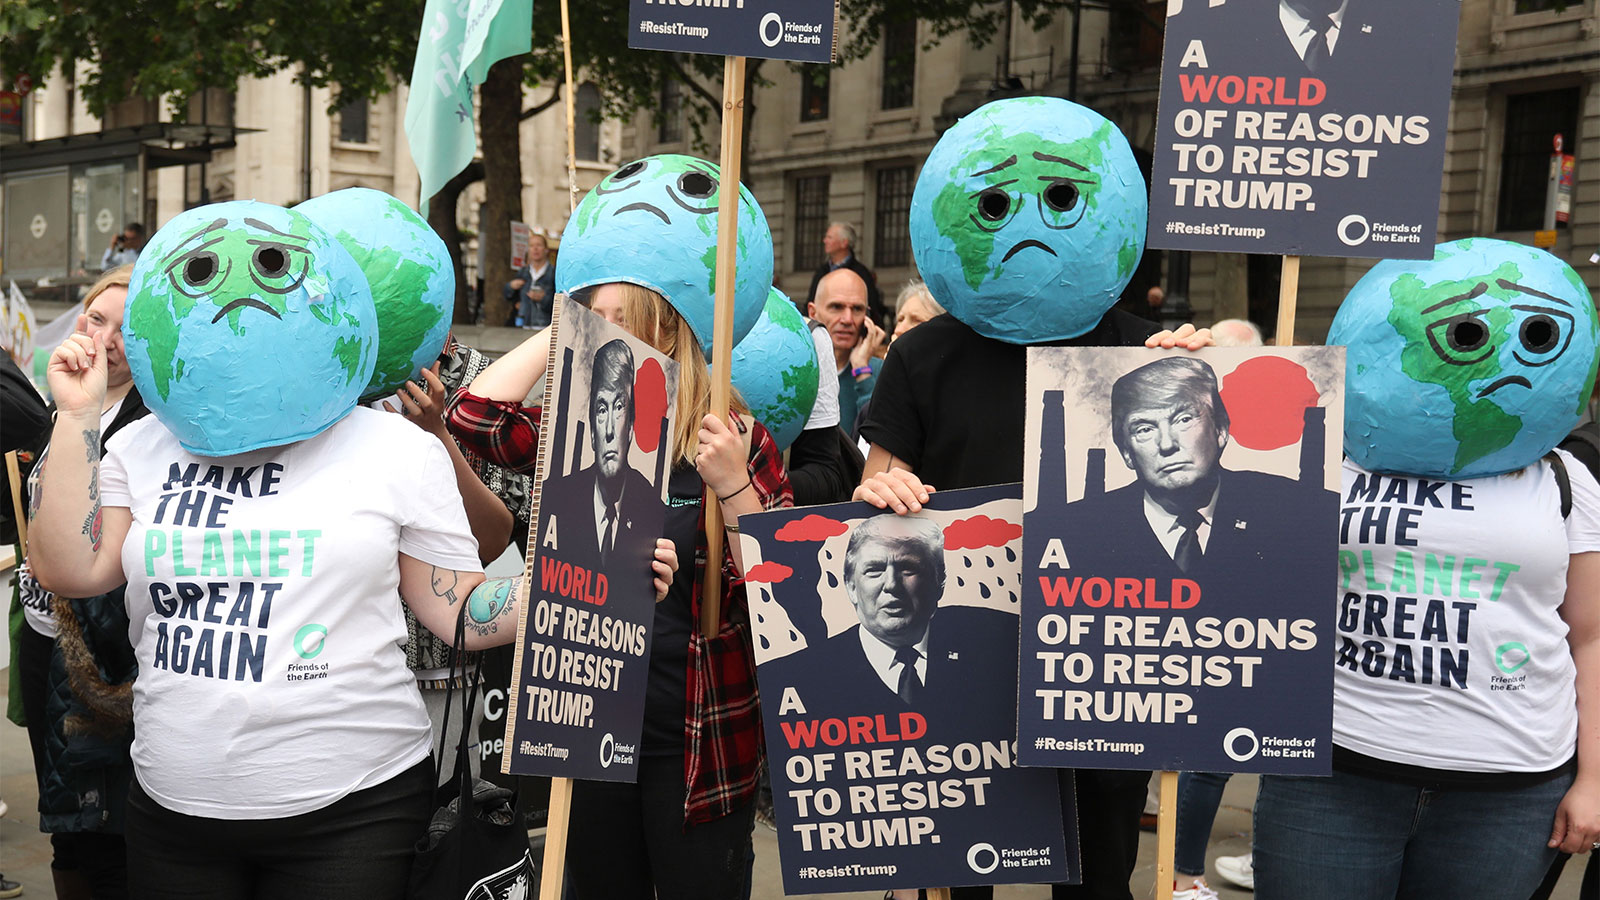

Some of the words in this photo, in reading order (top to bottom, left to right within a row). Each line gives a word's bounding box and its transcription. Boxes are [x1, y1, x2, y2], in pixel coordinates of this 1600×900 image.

[640, 21, 709, 39] #ResistTrump
[784, 33, 797, 43] the
[798, 34, 820, 45] Earth
[785, 22, 812, 33] Friends
[813, 24, 822, 33] of
[1179, 39, 1208, 68] A
[1178, 74, 1327, 106] WORLD
[1174, 109, 1228, 138] OF
[1234, 111, 1430, 145] REASONS
[1172, 143, 1224, 173] TO
[1232, 145, 1378, 178] RESIST
[1169, 178, 1315, 211] TRUMP.
[1166, 221, 1266, 239] #ResistTrump
[1372, 233, 1389, 242] the
[1390, 233, 1420, 243] Earth
[1373, 223, 1409, 233] Friends
[1410, 224, 1422, 233] of
[162, 462, 284, 498] MAKE
[1346, 473, 1475, 511] MAKE
[153, 490, 233, 528] THE
[1341, 507, 1423, 546] THE
[543, 514, 558, 550] A
[144, 529, 322, 577] PLANET
[1039, 538, 1071, 569] A
[541, 555, 608, 606] WORLD
[1039, 576, 1201, 609] WORLD
[1338, 550, 1521, 601] PLANET
[149, 582, 283, 629] GREAT
[1338, 593, 1477, 644] GREAT
[534, 599, 562, 637] OF
[562, 605, 646, 657] REASONS
[1037, 614, 1095, 645] OF
[1104, 615, 1318, 651] REASONS
[153, 622, 268, 683] AGAIN
[288, 663, 319, 671] Friends
[320, 662, 329, 670] of
[531, 642, 557, 680] TO
[558, 648, 624, 692] RESIST
[1037, 652, 1094, 683] TO
[1103, 653, 1262, 687] RESIST
[1336, 637, 1469, 689] AGAIN
[287, 673, 302, 681] the
[304, 672, 327, 680] Earth
[526, 685, 594, 728] TRUMP.
[779, 687, 807, 716] A
[1035, 689, 1198, 724] TRUMP.
[780, 712, 927, 749] WORLD
[1035, 738, 1144, 755] #ResistTrump
[1262, 737, 1303, 747] Friends
[1304, 738, 1316, 747] of
[519, 740, 569, 760] #ResistTrump
[786, 753, 836, 784] OF
[845, 740, 1018, 780] REASON
[1261, 748, 1281, 757] the
[1282, 748, 1315, 758] Earth
[788, 788, 841, 817] TO
[849, 777, 991, 814] RESIST
[793, 816, 941, 851] TRUMP.
[1001, 848, 1039, 858] Friends
[1039, 847, 1050, 856] of
[1002, 859, 1020, 868] the
[1021, 857, 1051, 867] Earth
[799, 864, 897, 879] #ResistTrump
